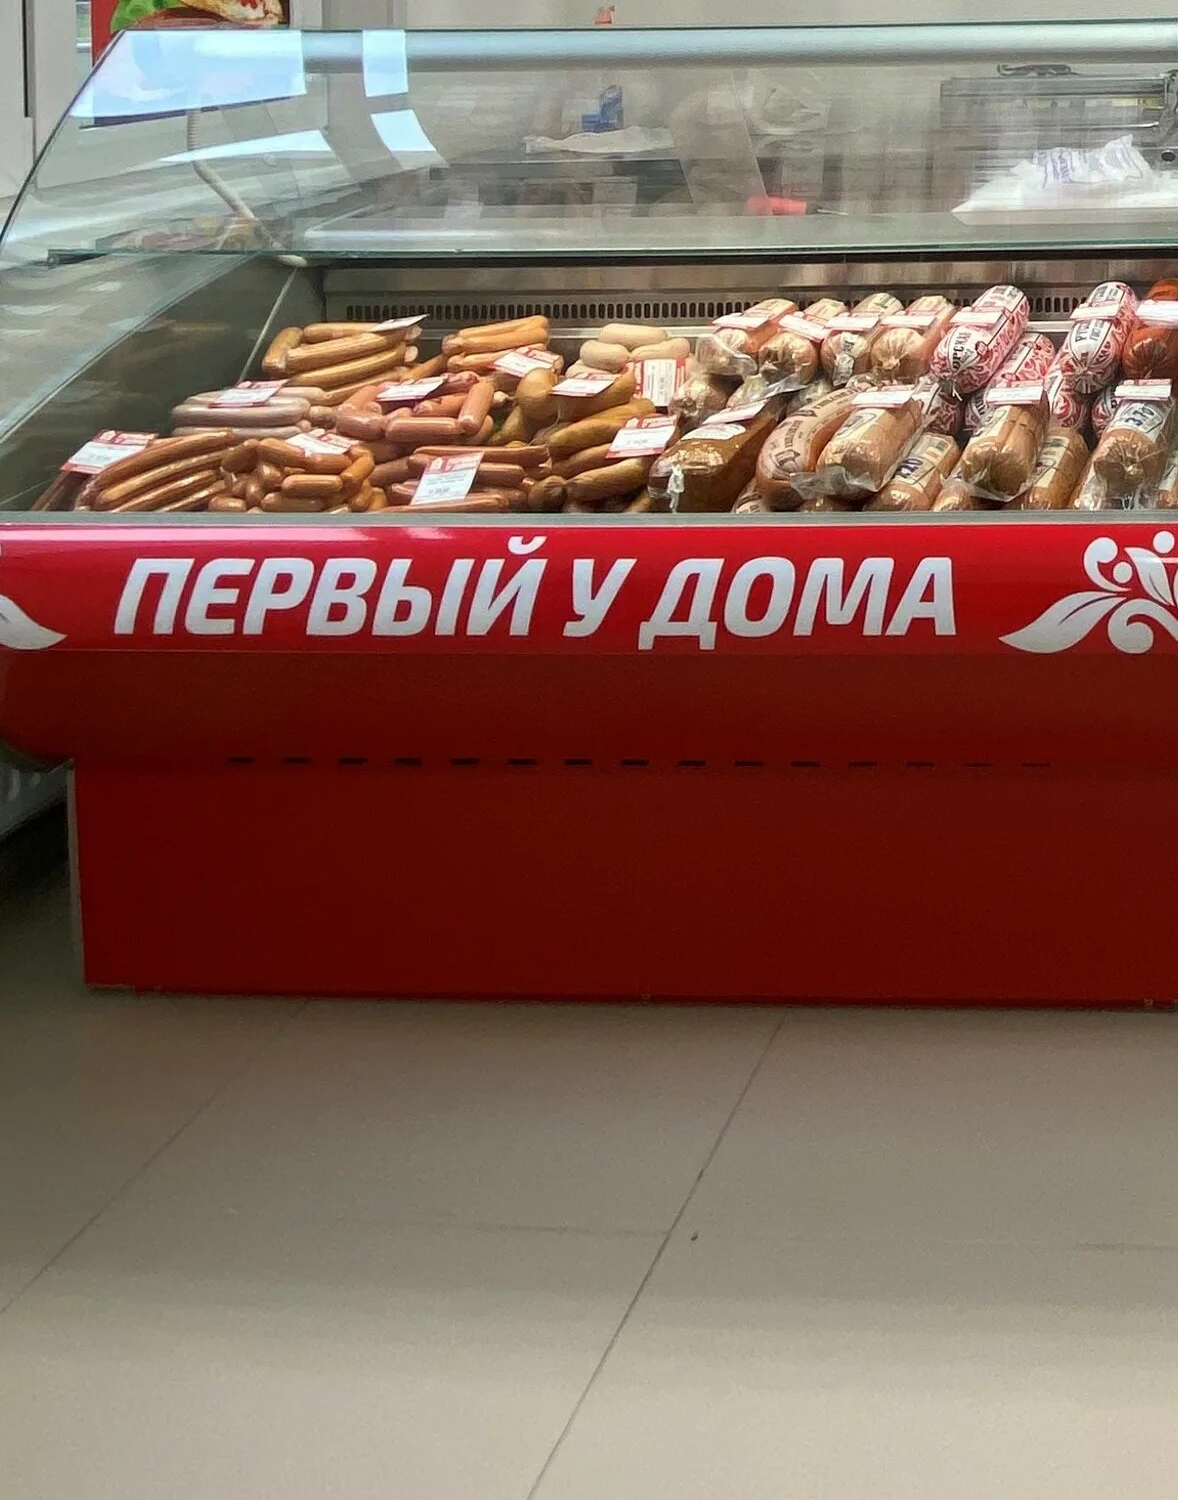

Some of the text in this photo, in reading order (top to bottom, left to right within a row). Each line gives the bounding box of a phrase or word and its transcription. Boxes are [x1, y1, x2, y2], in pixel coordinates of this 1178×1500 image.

[113, 535, 957, 651] ПЕРВЫЙ У ДОМА
